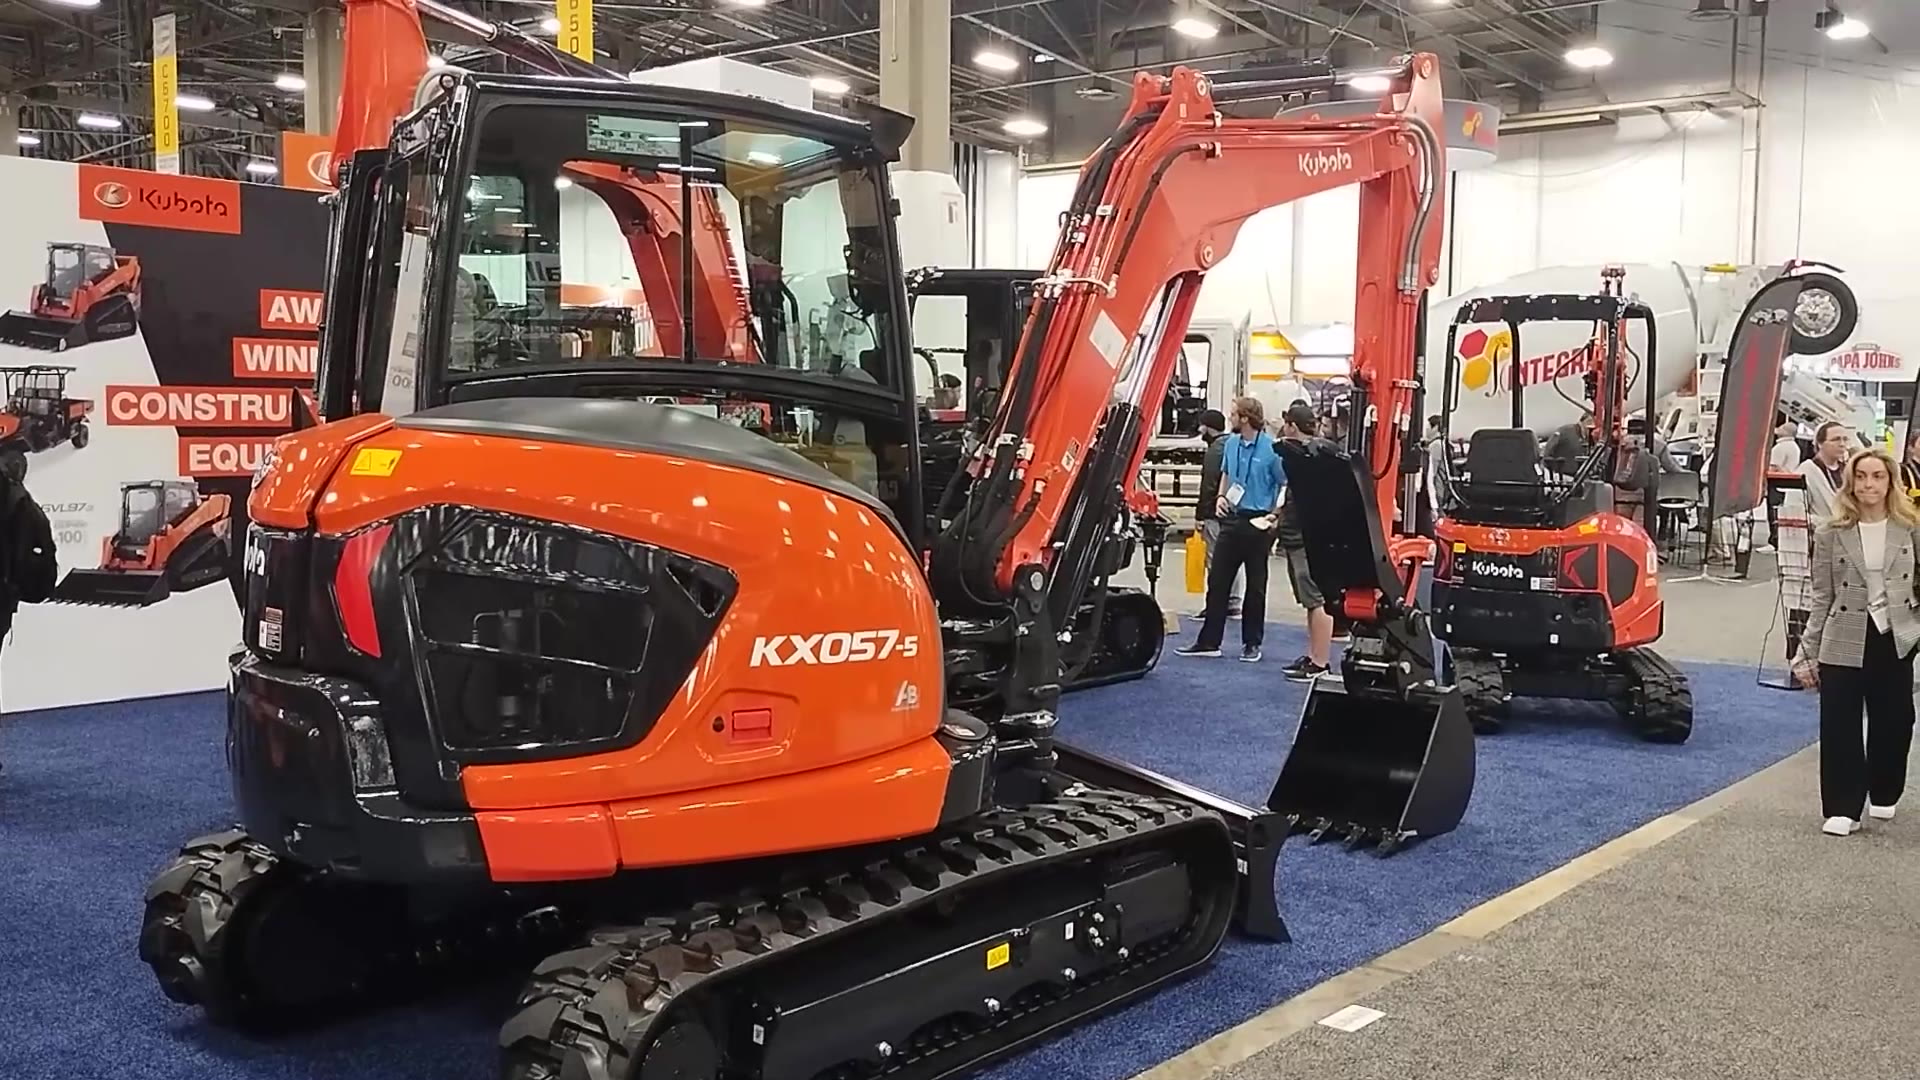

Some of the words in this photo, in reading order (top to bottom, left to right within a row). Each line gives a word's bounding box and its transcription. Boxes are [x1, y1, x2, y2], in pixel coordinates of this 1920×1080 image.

[161, 63, 171, 147] C6700
[1298, 147, 1352, 177] Kubota
[139, 187, 228, 217] Kubota
[266, 295, 322, 325] AW
[1508, 346, 1592, 392] INTEGR
[111, 391, 312, 421] CONSTRU
[1471, 560, 1524, 580] Kubota
[749, 628, 919, 668] KX057-5
